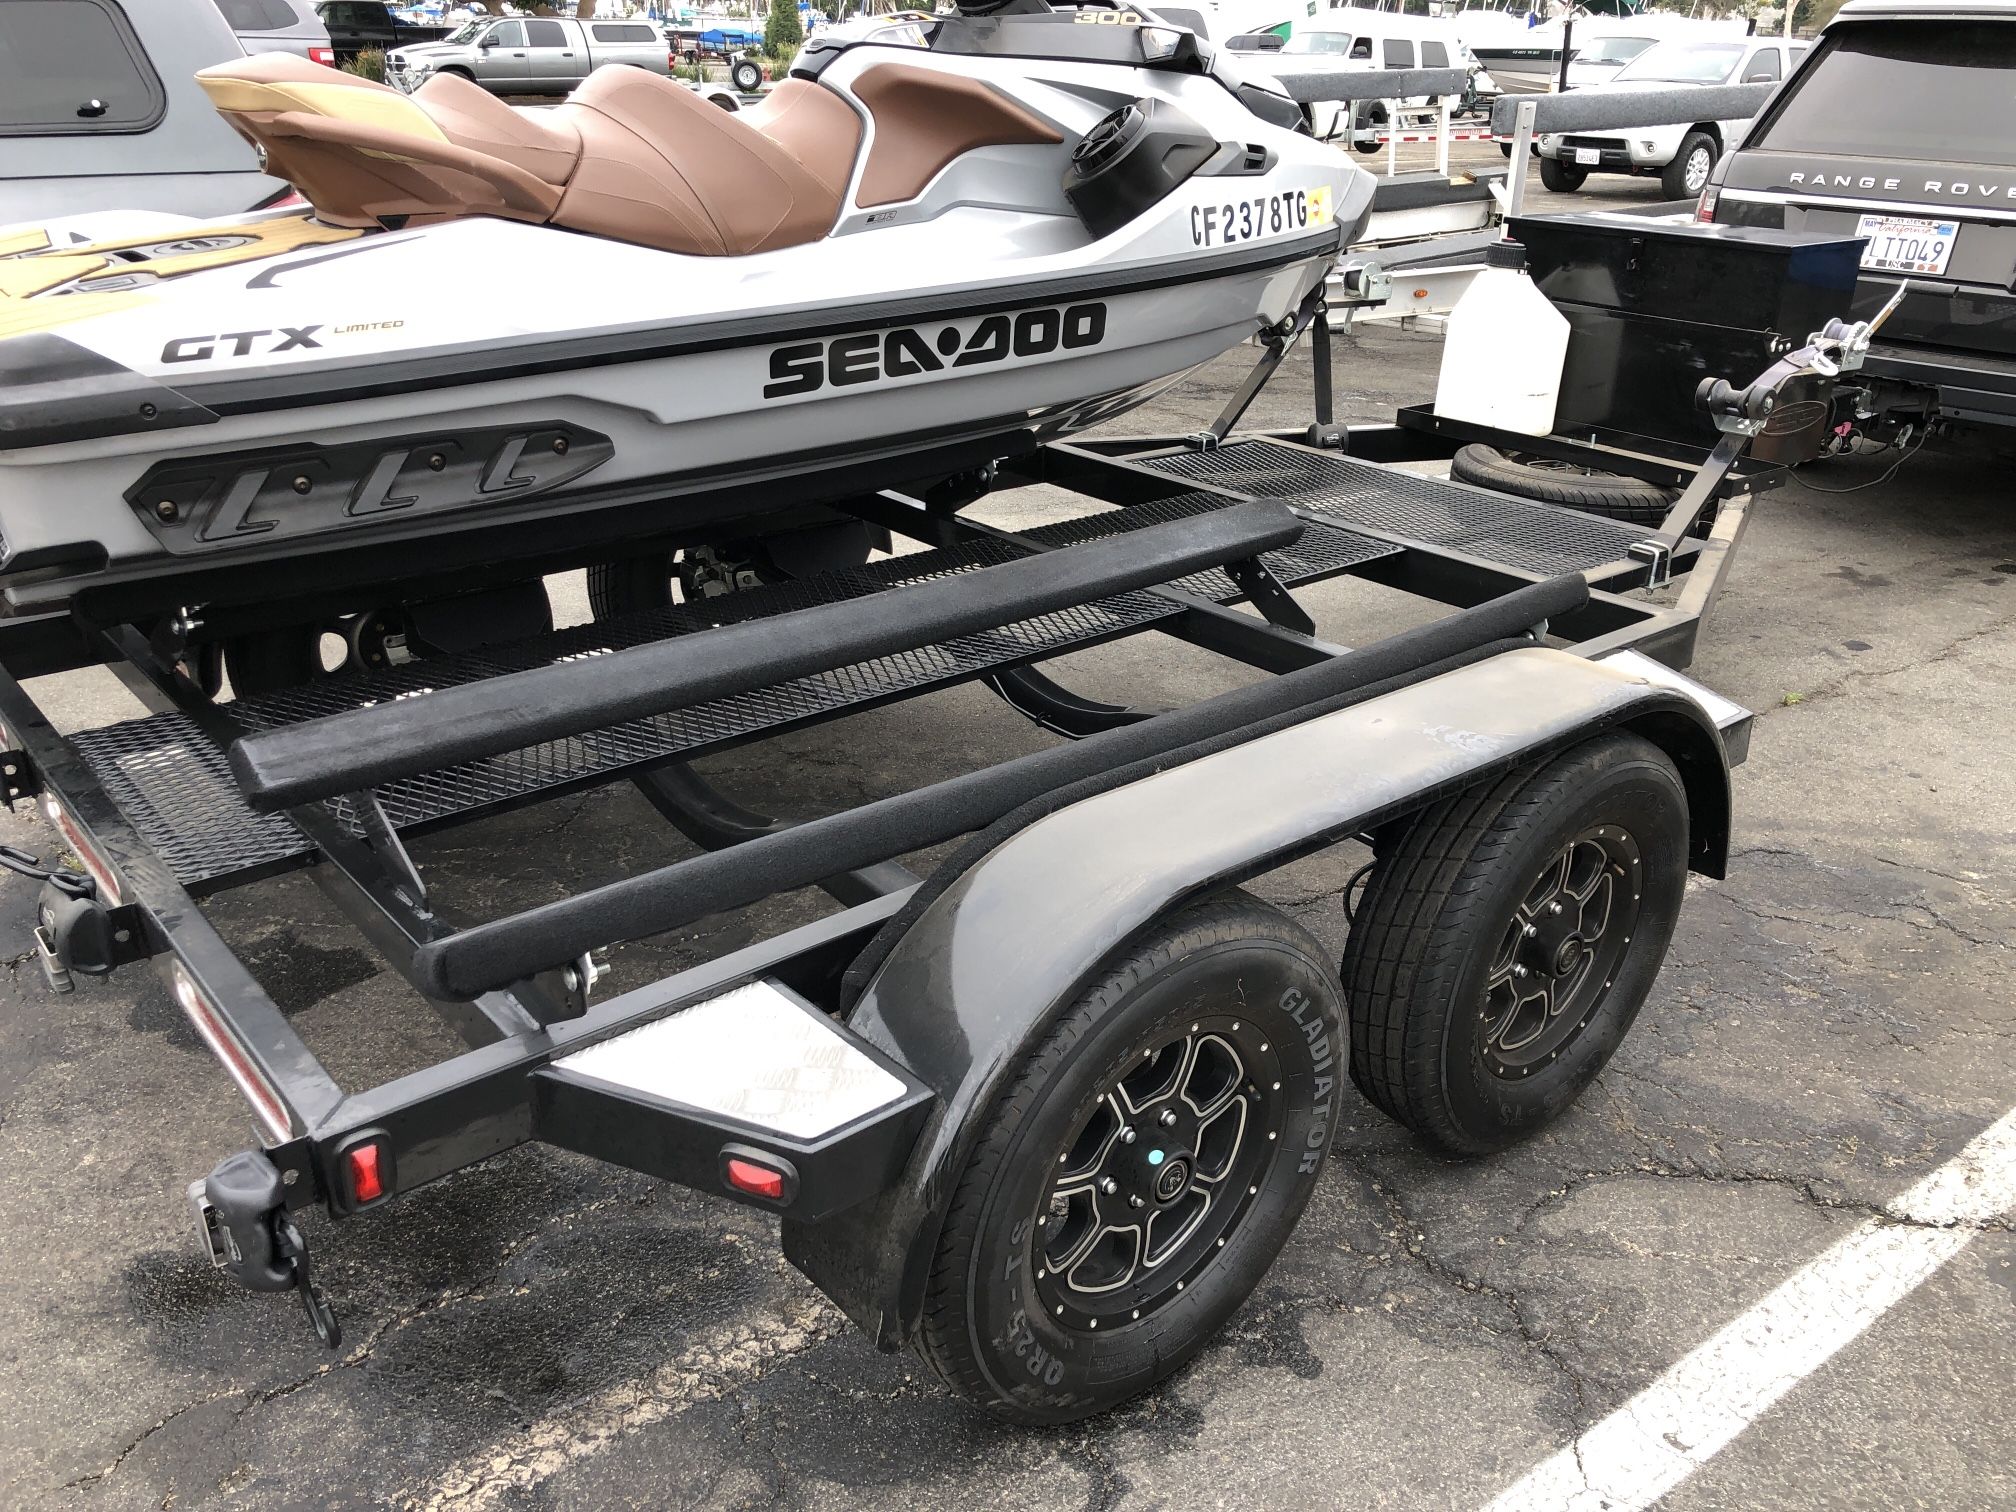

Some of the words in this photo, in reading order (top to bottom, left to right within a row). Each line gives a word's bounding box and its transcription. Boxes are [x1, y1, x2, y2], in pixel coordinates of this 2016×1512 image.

[1074, 11, 1142, 26] 300
[1789, 172, 1901, 190] RANGE
[161, 324, 325, 364] GTX
[334, 320, 404, 334] LIMITED
[1278, 986, 1335, 1175] GLADIATOR
